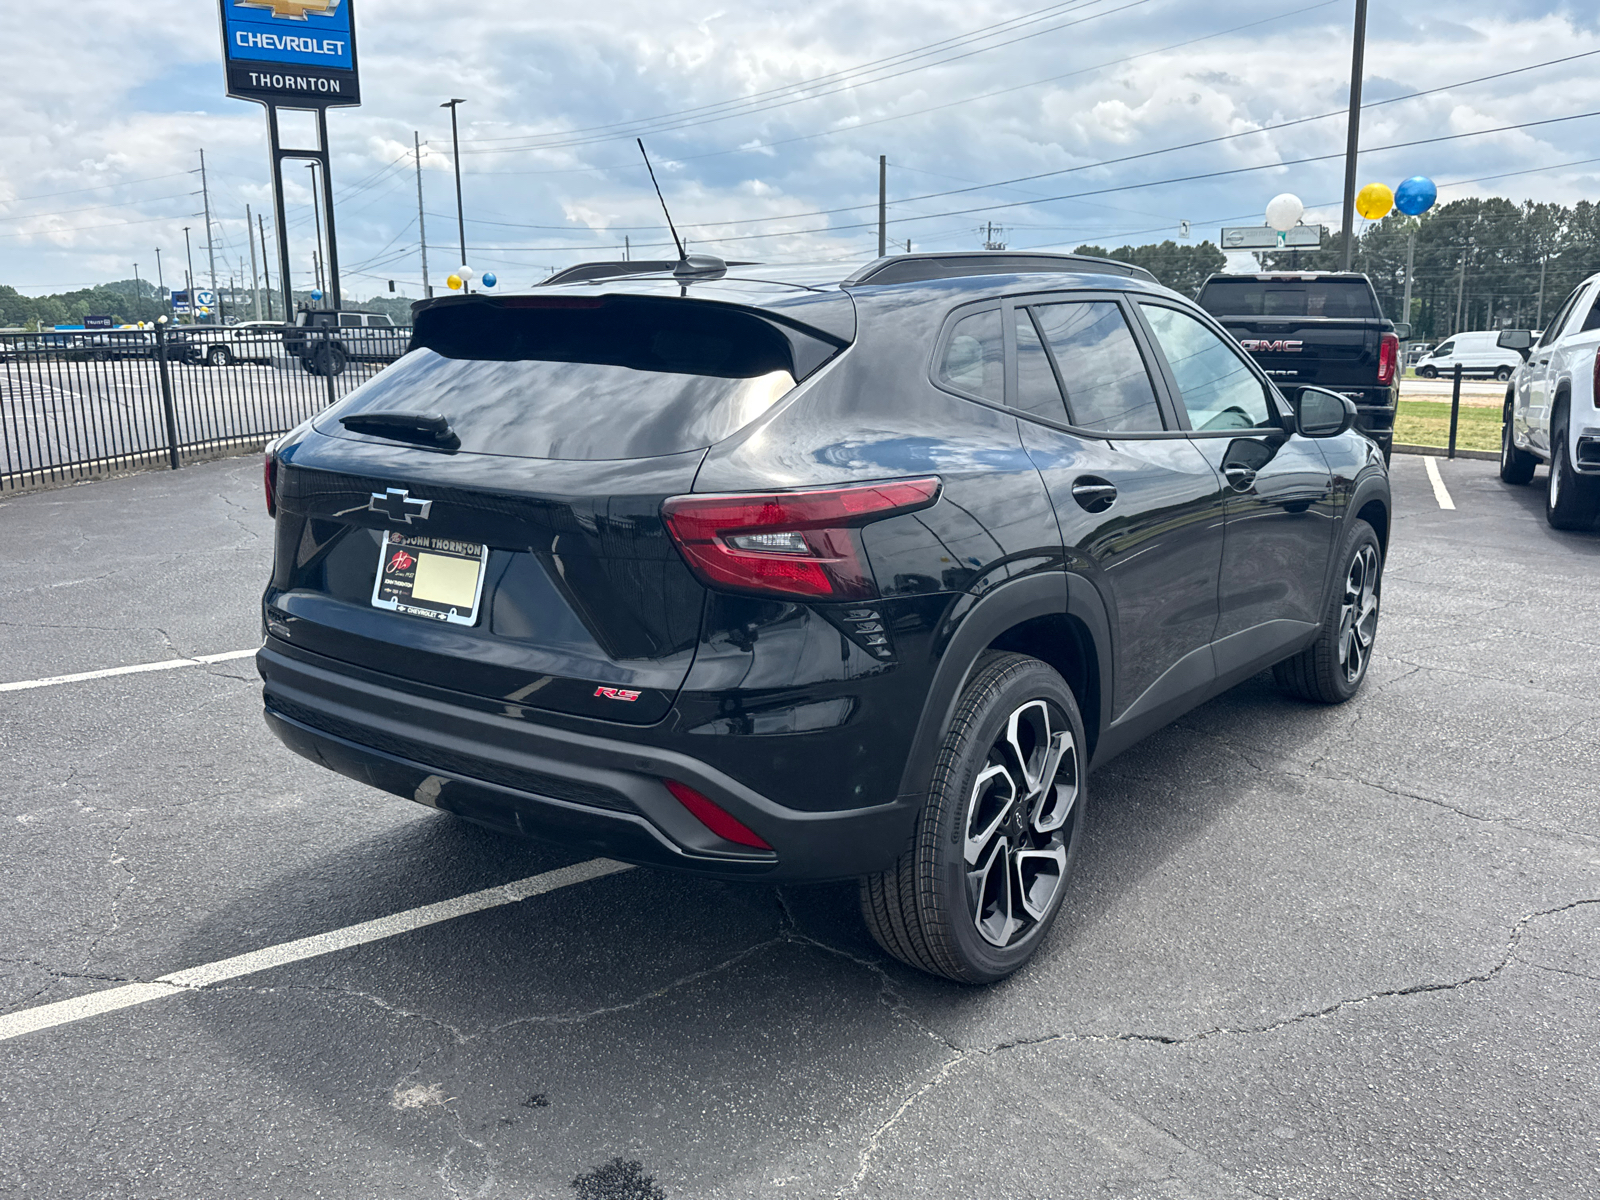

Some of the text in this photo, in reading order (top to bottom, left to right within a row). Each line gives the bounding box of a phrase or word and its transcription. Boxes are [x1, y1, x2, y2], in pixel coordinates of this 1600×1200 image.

[236, 31, 345, 55] CHEVROLET
[249, 72, 340, 93] THORNTON
[1240, 339, 1304, 352] GMC
[431, 538, 481, 556] THORNTON
[407, 607, 437, 618] CHEVROLET
[593, 686, 642, 701] RS
[951, 767, 972, 844] Continental
